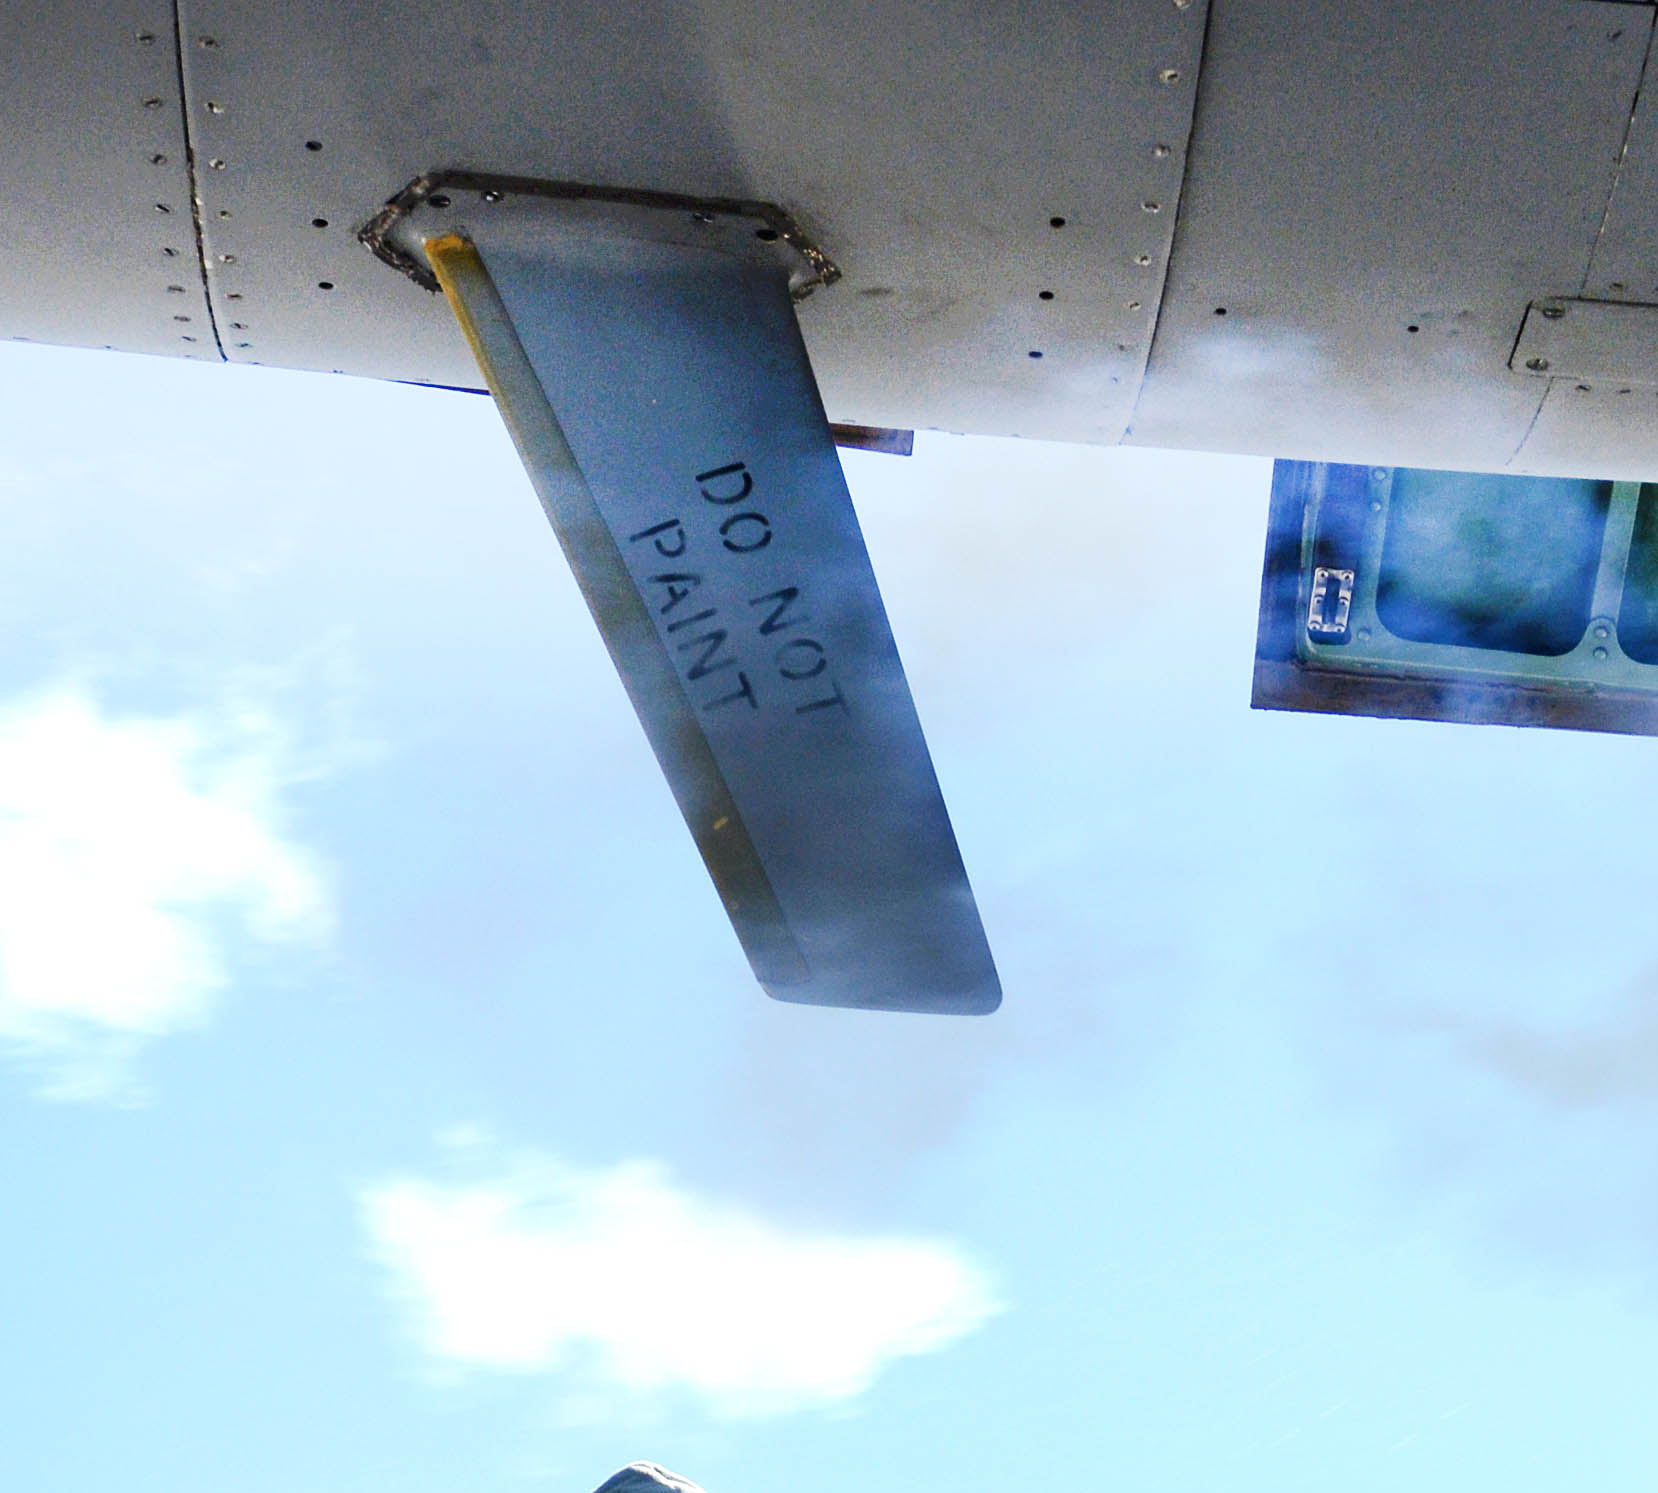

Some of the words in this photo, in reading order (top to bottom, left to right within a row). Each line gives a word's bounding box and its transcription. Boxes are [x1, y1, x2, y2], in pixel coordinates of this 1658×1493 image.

[630, 518, 758, 712] PAINT
[696, 462, 772, 553] DO
[751, 586, 849, 714] NOT
